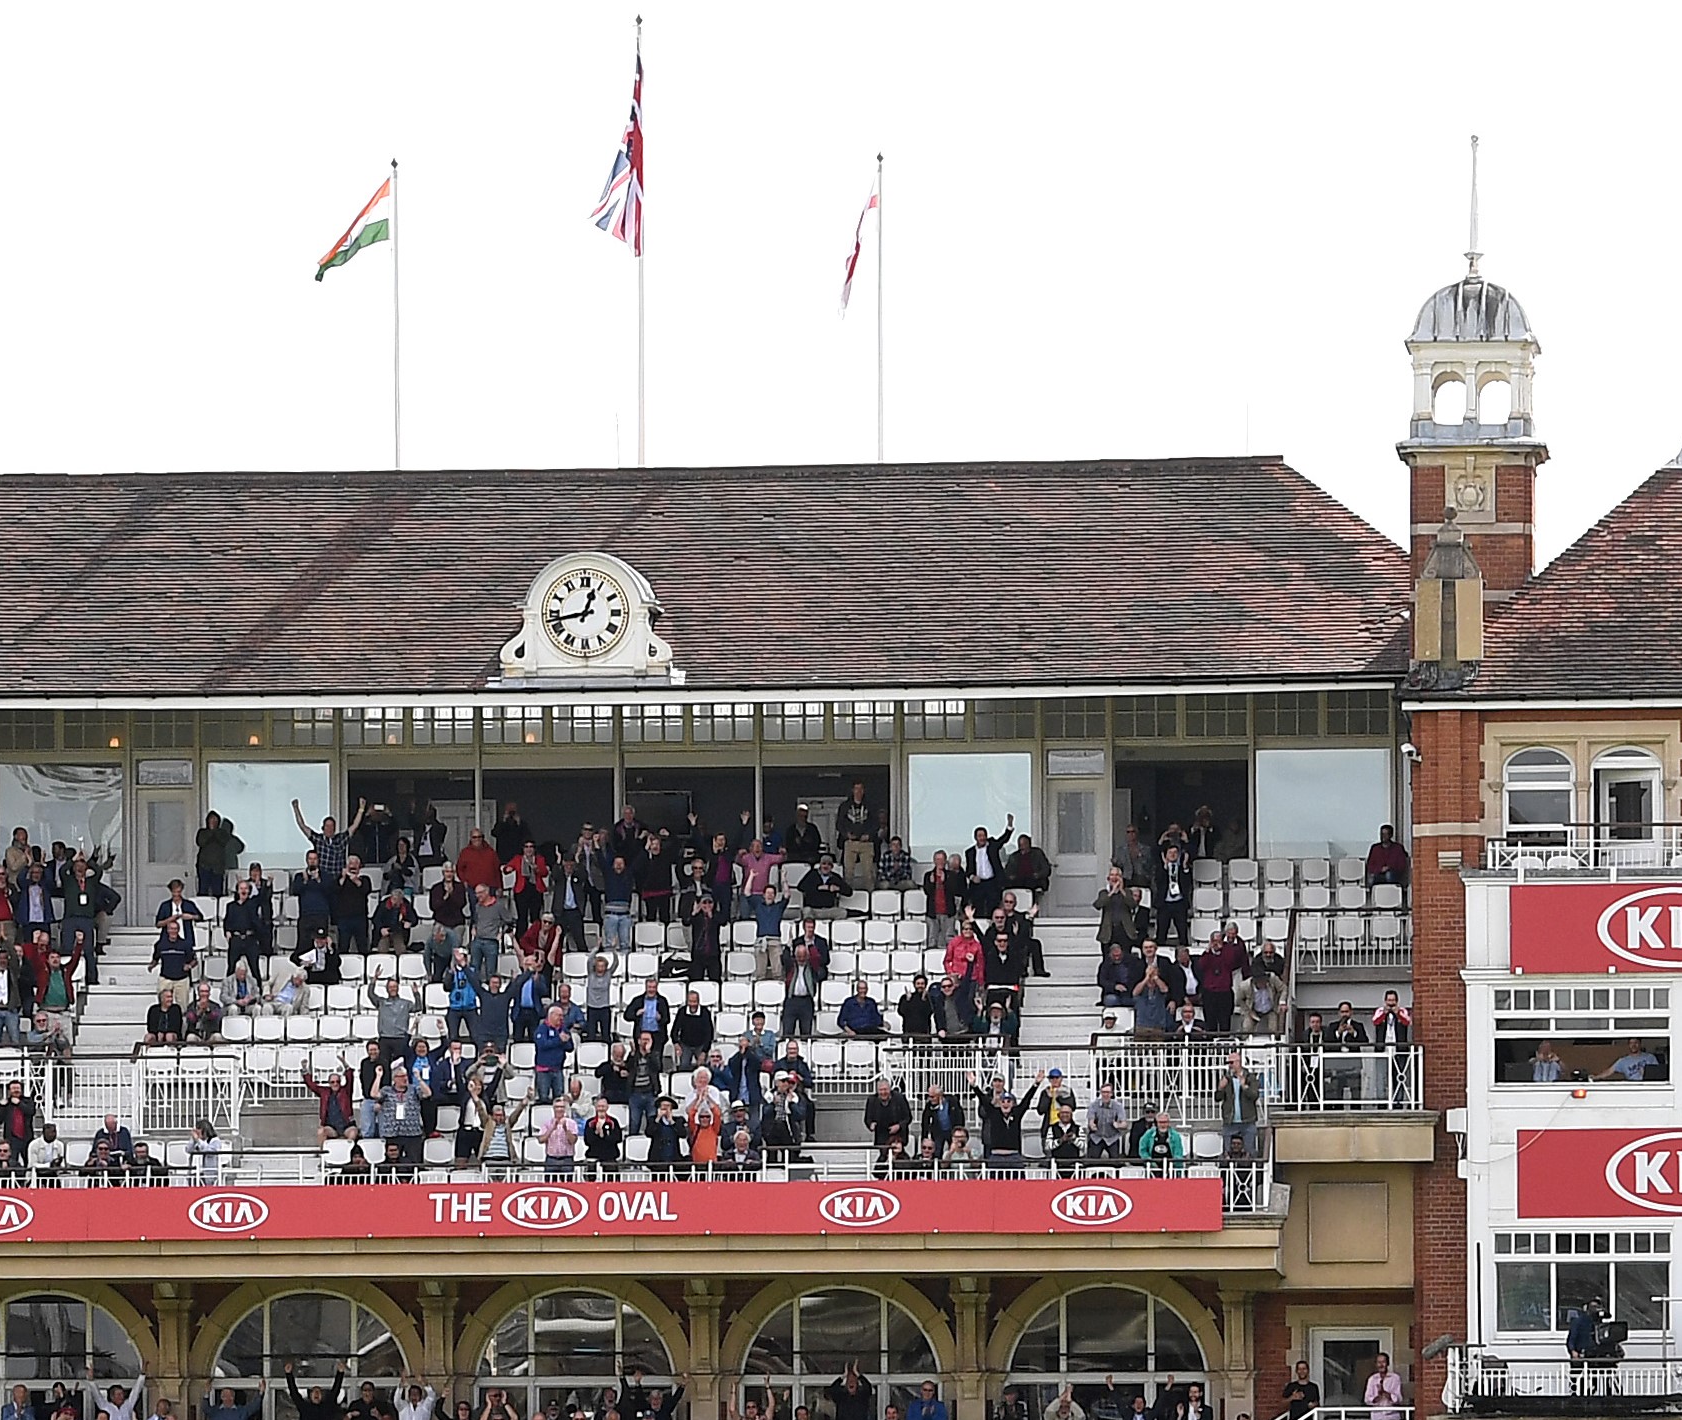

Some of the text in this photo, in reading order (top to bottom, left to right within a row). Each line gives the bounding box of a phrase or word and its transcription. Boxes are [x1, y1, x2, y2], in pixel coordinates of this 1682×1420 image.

[201, 1200, 256, 1225] KIA
[431, 1192, 677, 1221] THE KIA OVAL
[832, 1193, 887, 1220] KIA
[1065, 1192, 1120, 1219] KIA
